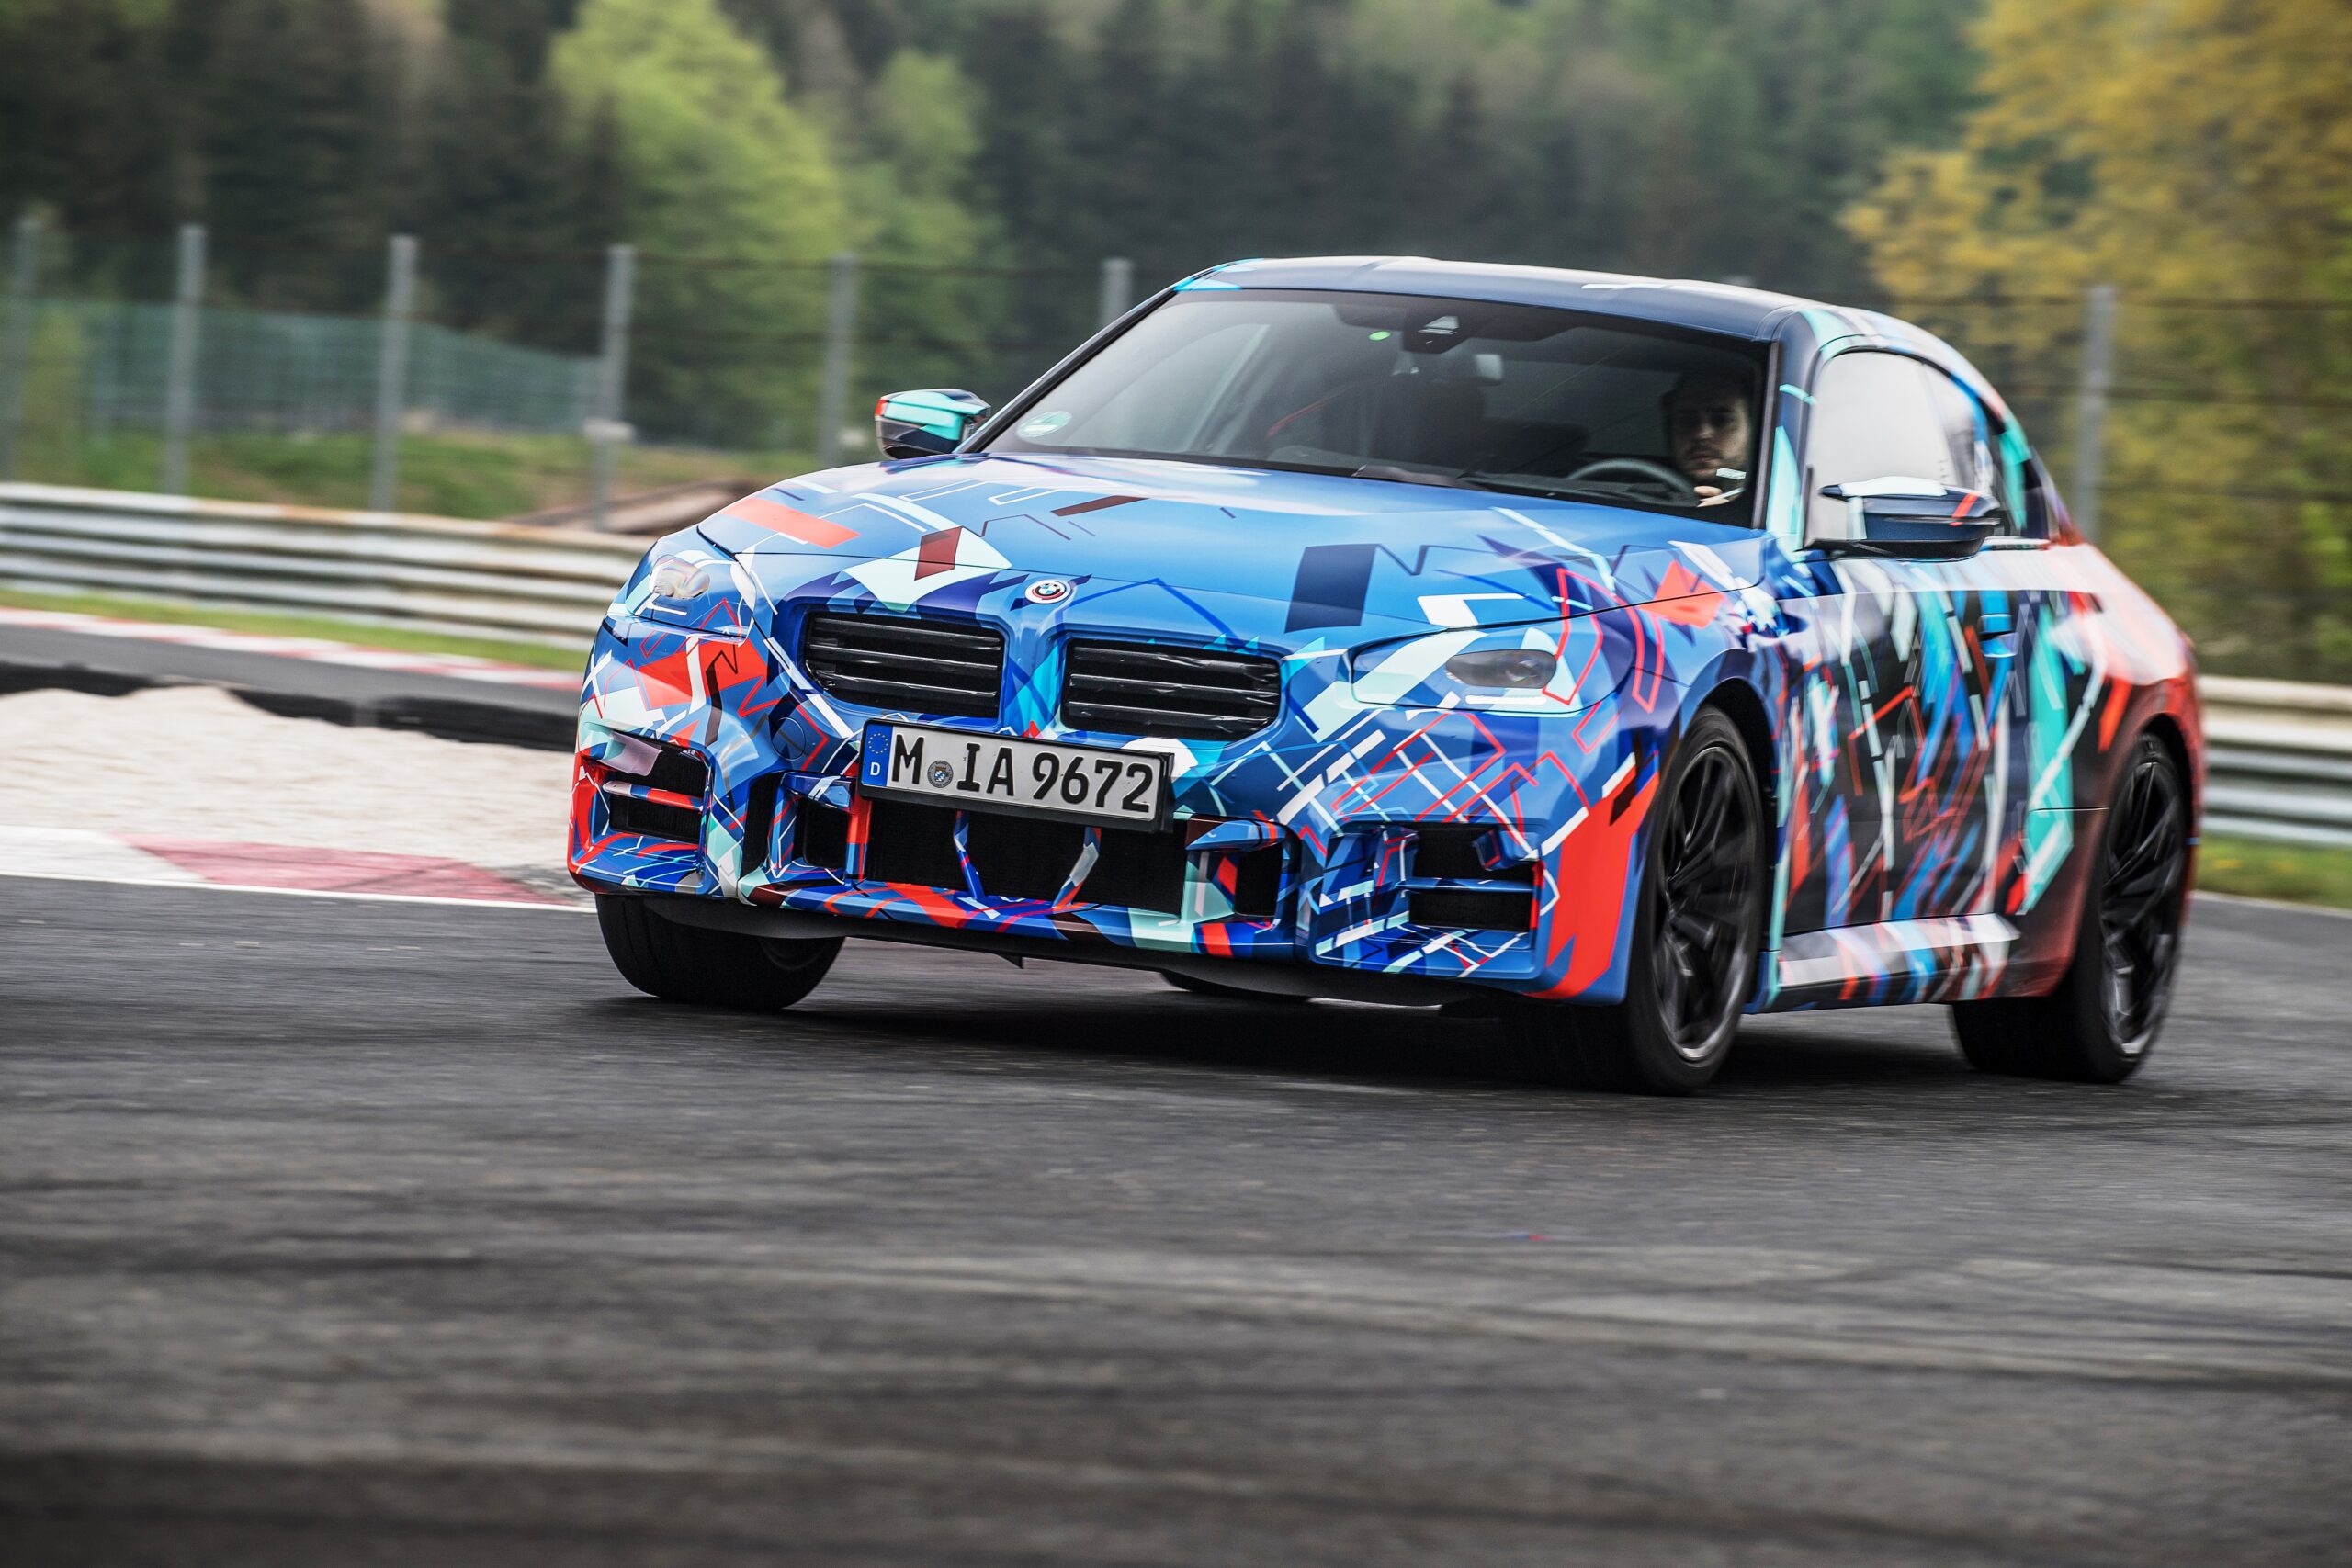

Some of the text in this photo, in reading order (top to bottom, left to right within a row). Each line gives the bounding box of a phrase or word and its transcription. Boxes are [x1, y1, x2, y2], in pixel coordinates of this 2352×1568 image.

[870, 761, 881, 776] D
[892, 734, 924, 784] M
[956, 742, 1014, 796] IA
[1032, 752, 1153, 813] 9672
